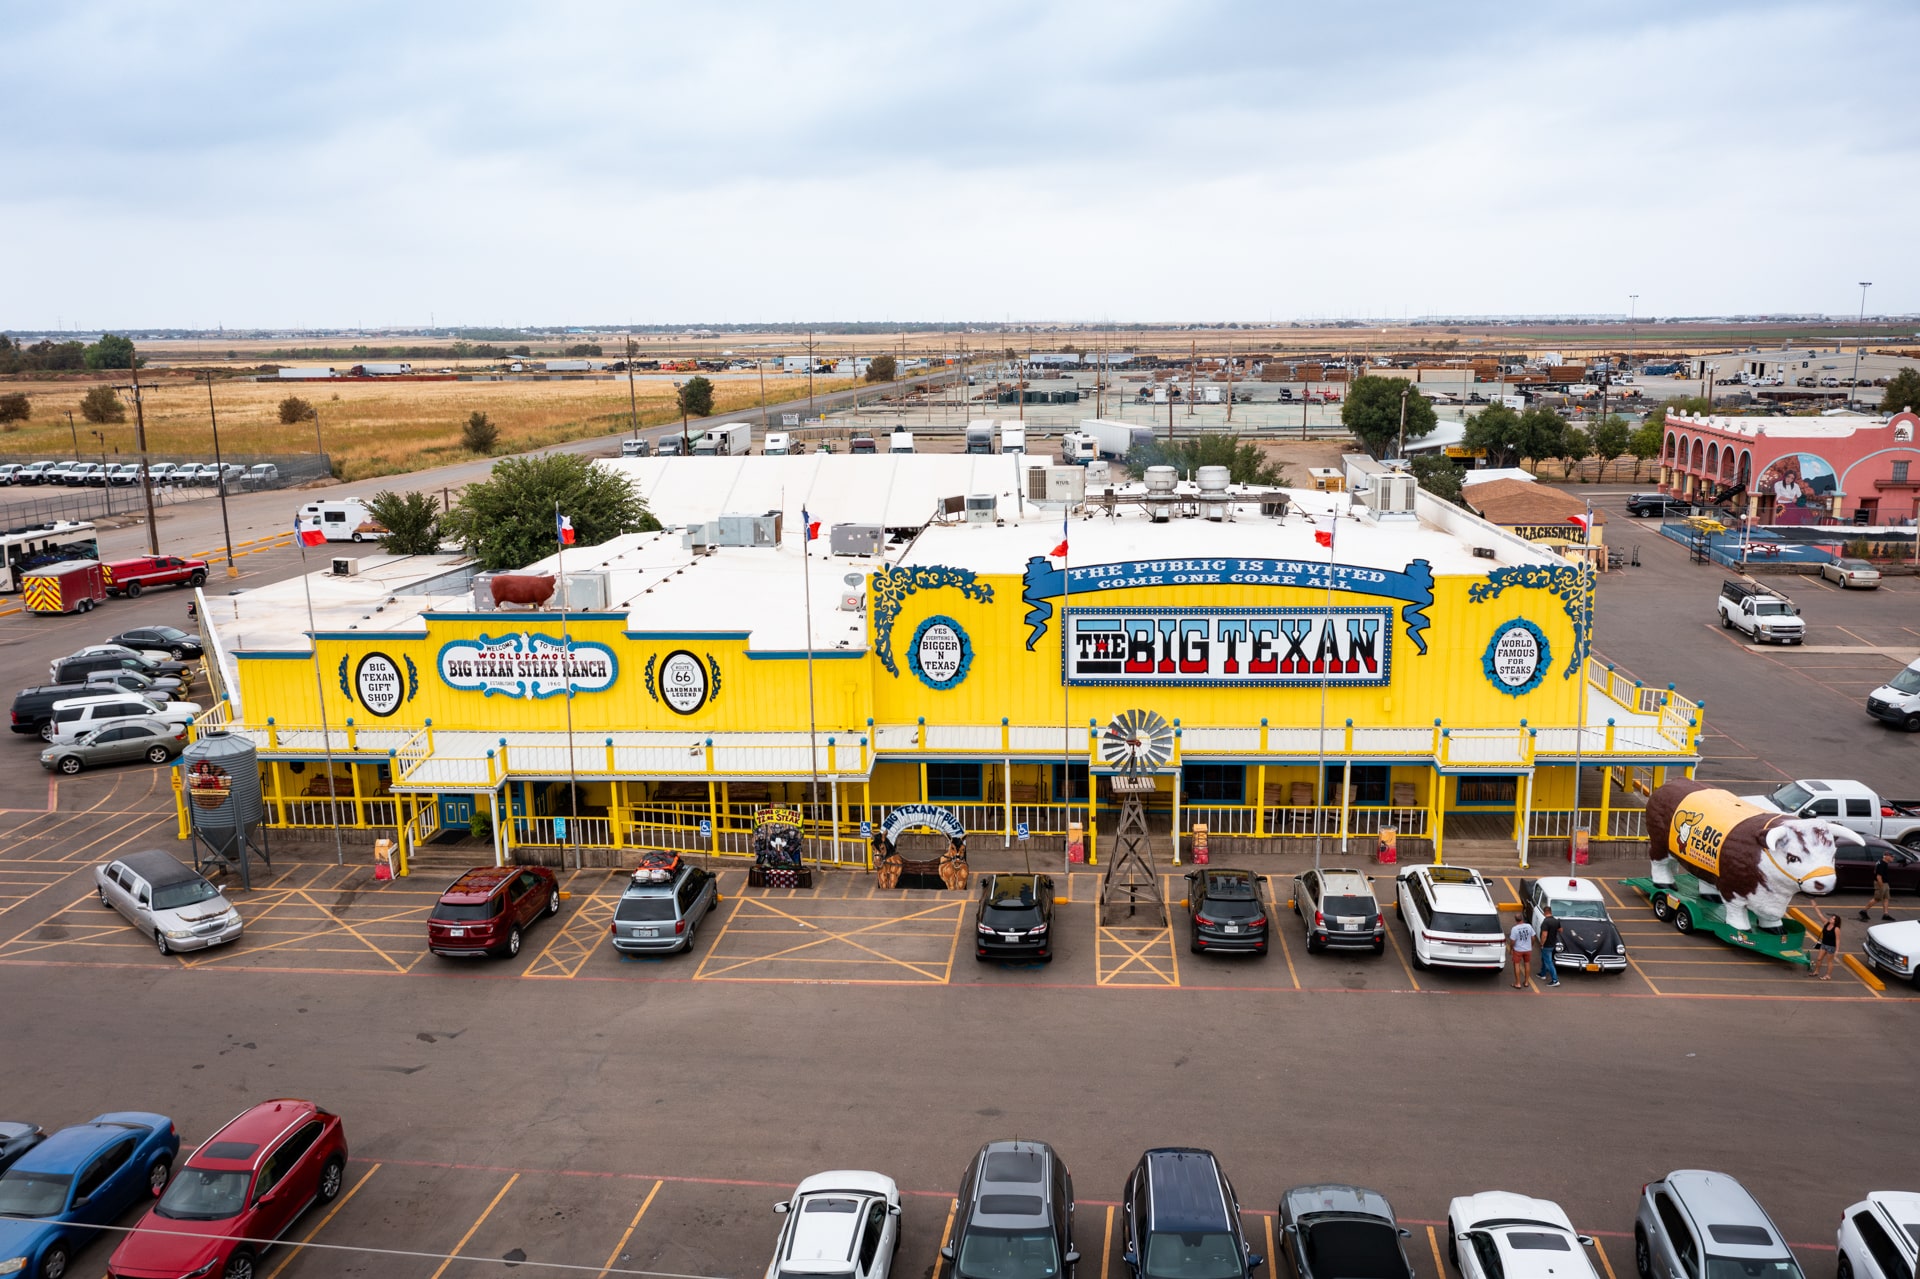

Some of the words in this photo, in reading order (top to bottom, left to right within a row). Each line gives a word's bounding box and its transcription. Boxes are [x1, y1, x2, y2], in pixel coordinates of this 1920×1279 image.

[1514, 526, 1585, 544] BLACKSMITH
[1069, 564, 1123, 580] THE
[1133, 560, 1226, 574] PUBLIC
[1237, 560, 1264, 571] IS
[1274, 561, 1386, 583] INVITED
[1097, 575, 1163, 588] COME
[1172, 573, 1220, 583] ONE
[1230, 573, 1296, 585] COME
[1306, 577, 1351, 590] ALL
[486, 641, 513, 652] WELCOME
[539, 641, 547, 649] TO
[550, 645, 564, 653] THE
[922, 641, 958, 650] BIGGER
[1076, 634, 1125, 659] THE
[1124, 618, 1209, 674] BIG
[1217, 618, 1379, 674] TEXAN
[1501, 639, 1532, 647] WORLD
[478, 652, 521, 660] WORLD
[525, 652, 576, 660] FAMOUS
[935, 651, 944, 659] 'N
[1497, 649, 1535, 657] FAMOUS
[369, 663, 386, 671] BIG
[448, 660, 473, 677] BIG
[474, 660, 514, 677] TEXAN
[518, 660, 559, 677] STEAK
[562, 660, 607, 677] RANCH
[924, 661, 956, 670] TEXAS
[1499, 665, 1531, 674] STEAKS
[362, 673, 395, 681] TEXAN
[675, 671, 691, 682] 66
[368, 683, 391, 691] GIFT
[367, 693, 394, 701] SHOP
[776, 813, 801, 825] STEAK
[882, 813, 899, 830] BIG
[896, 804, 939, 816] TEXAN
[942, 812, 965, 835] BUST
[1702, 825, 1723, 847] BIG
[1690, 836, 1718, 859] TEXAN
